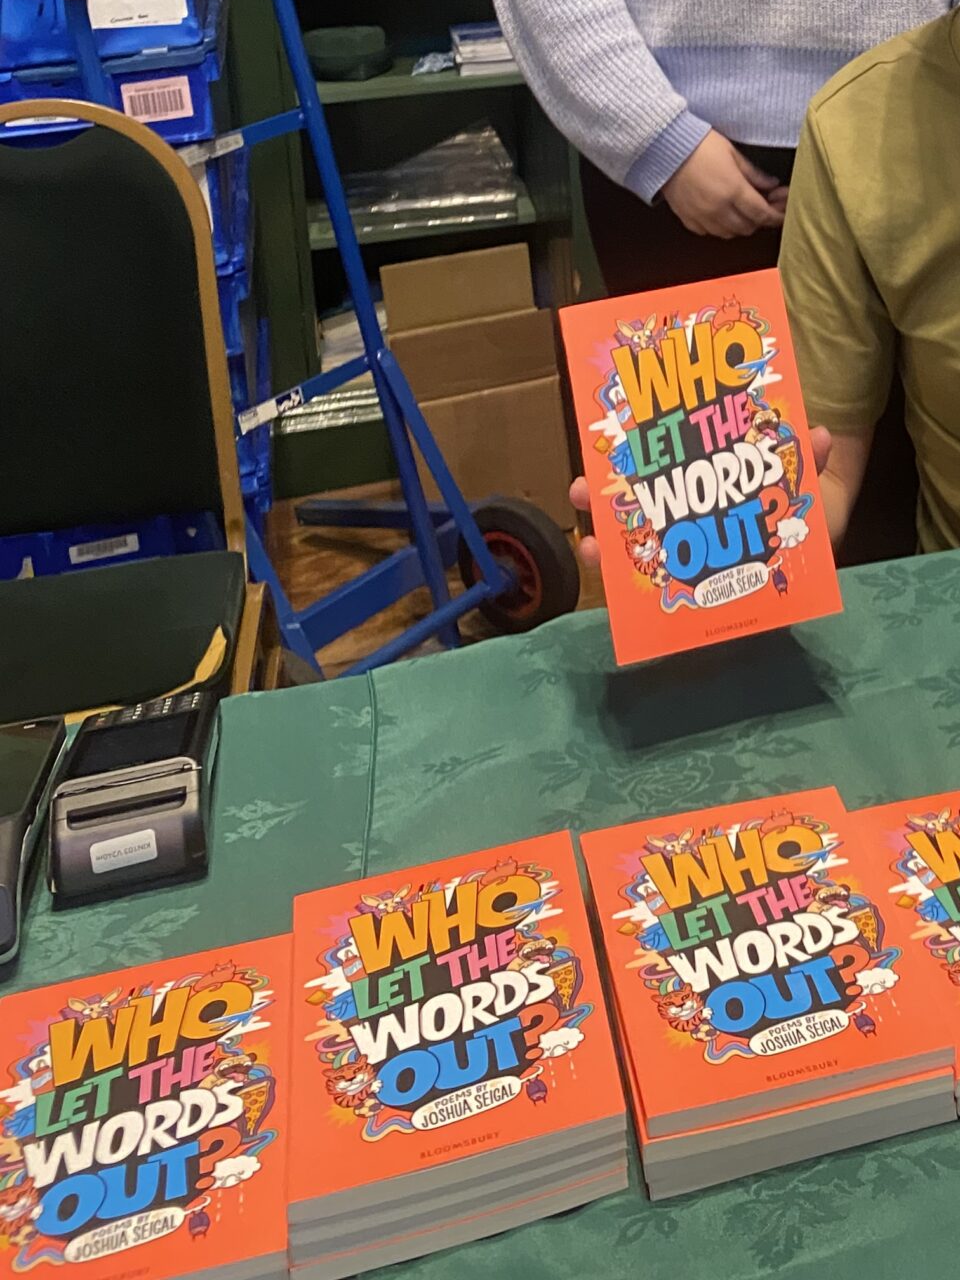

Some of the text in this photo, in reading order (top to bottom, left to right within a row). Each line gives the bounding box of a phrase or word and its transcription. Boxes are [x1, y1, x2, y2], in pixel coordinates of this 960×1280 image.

[610, 319, 763, 424] WHO
[626, 390, 751, 477] LET THE
[632, 437, 784, 532] WORDS
[662, 486, 790, 579] OUT?
[702, 582, 737, 605] JOSHUA
[709, 568, 746, 588] POEMS BY
[639, 825, 824, 909] WHO
[349, 875, 541, 974] WHO
[658, 874, 813, 950] LET THE
[667, 907, 860, 993] WORDS
[349, 963, 555, 1065] WORDS
[351, 929, 517, 1019] LET THE
[705, 944, 870, 1032] OUT?
[49, 981, 253, 1087] WHO
[376, 1002, 560, 1106] OUT?
[761, 1030, 807, 1054] JOSHUA
[766, 1060, 838, 1082] BLOOMSBURY
[768, 1020, 802, 1036] POEMS
[35, 1041, 218, 1138] LET THE
[421, 1100, 473, 1128] JOSHUA
[434, 1084, 488, 1109] POEMS BY
[24, 1080, 243, 1189] WORDS
[420, 1131, 500, 1159] BLOOMSBURY
[35, 1127, 242, 1236] OUT?
[74, 1231, 129, 1261] JOSHUA
[92, 1213, 152, 1239] POEMS BY
